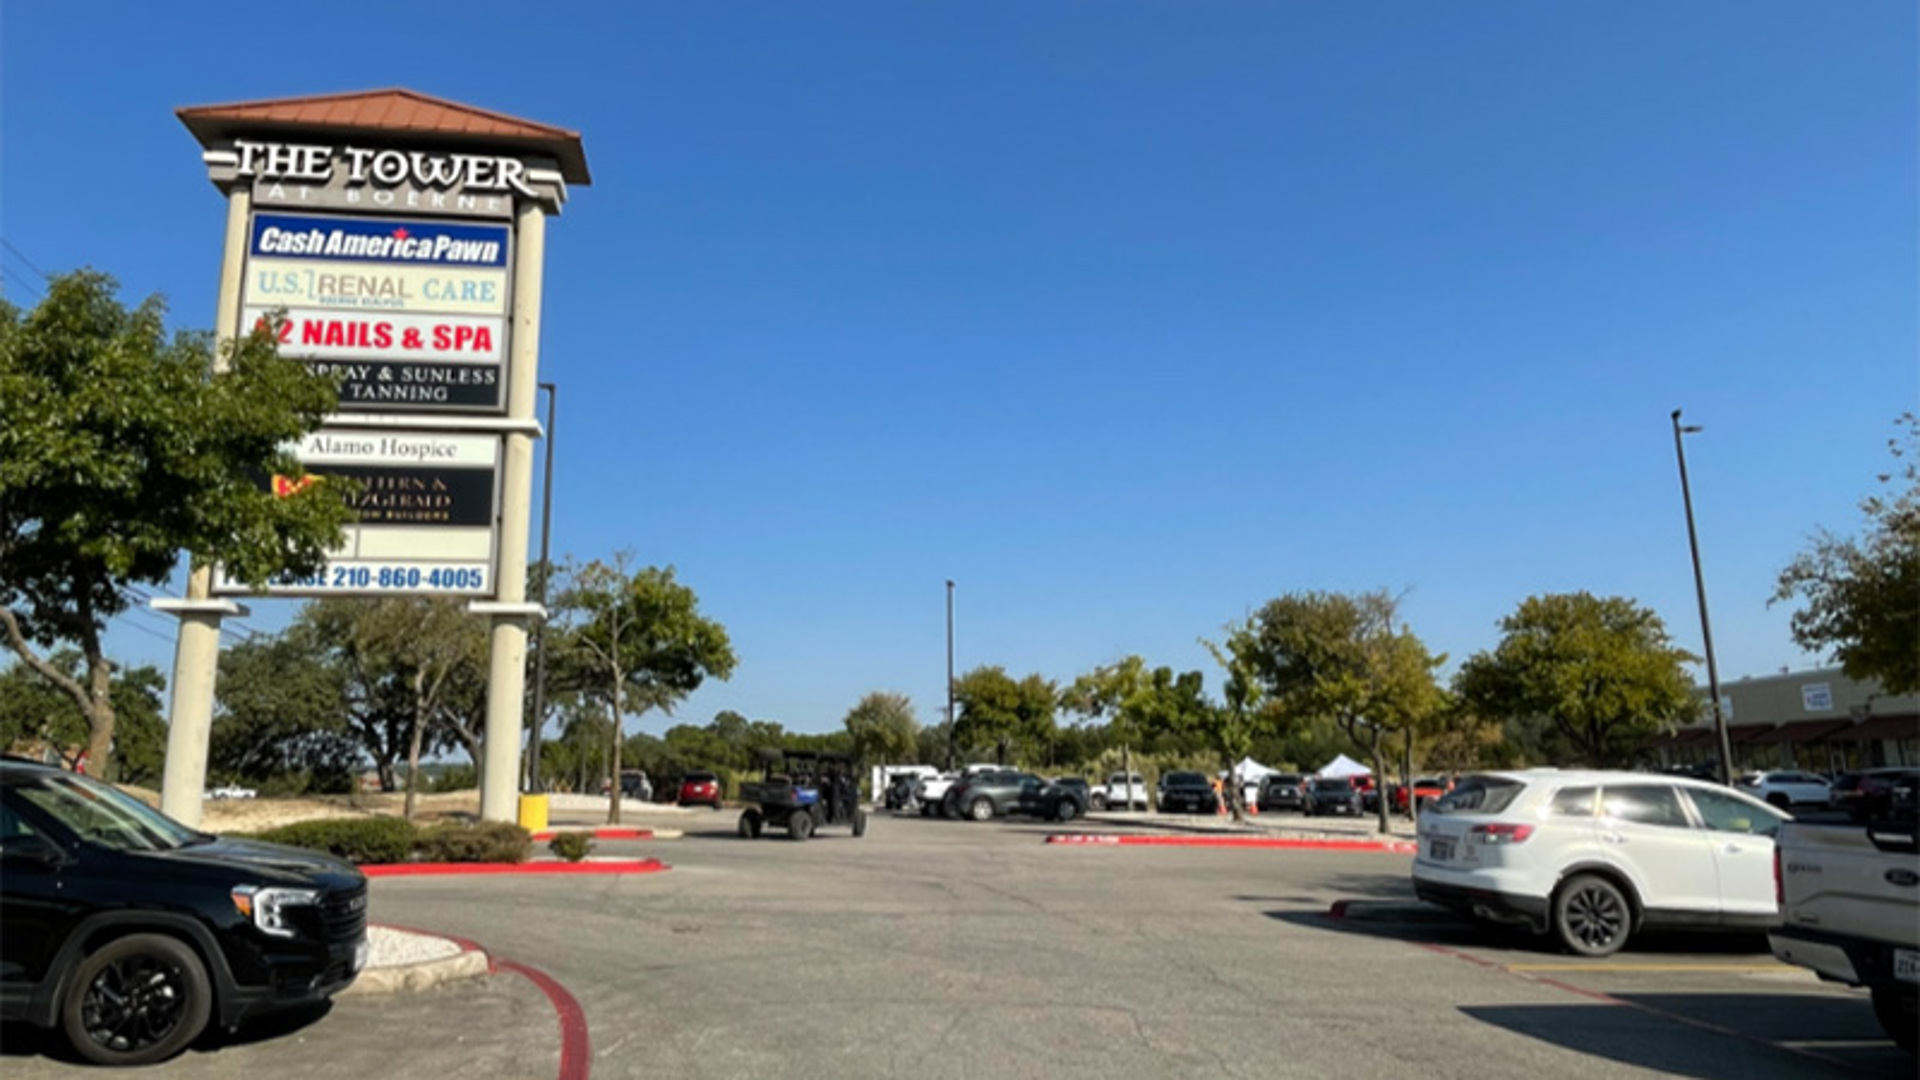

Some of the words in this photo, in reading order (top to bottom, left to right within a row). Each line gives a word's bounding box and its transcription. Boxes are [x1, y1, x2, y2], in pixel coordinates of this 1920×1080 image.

[234, 139, 332, 179] THE
[345, 146, 539, 197] TOWER
[267, 183, 310, 200] AT
[347, 189, 501, 212] BOERNE
[258, 270, 304, 295] U.S.
[317, 273, 413, 299] RENAL
[422, 278, 496, 303] CARE
[302, 318, 394, 350] NAILS
[401, 326, 424, 351] &
[432, 323, 493, 353] SPA
[376, 366, 394, 382] &
[401, 366, 496, 386] SUNLESS
[350, 382, 448, 402] TANNING
[308, 437, 375, 455] Alamo
[379, 438, 458, 461] Hospice
[333, 565, 483, 590] 210-860-4005
